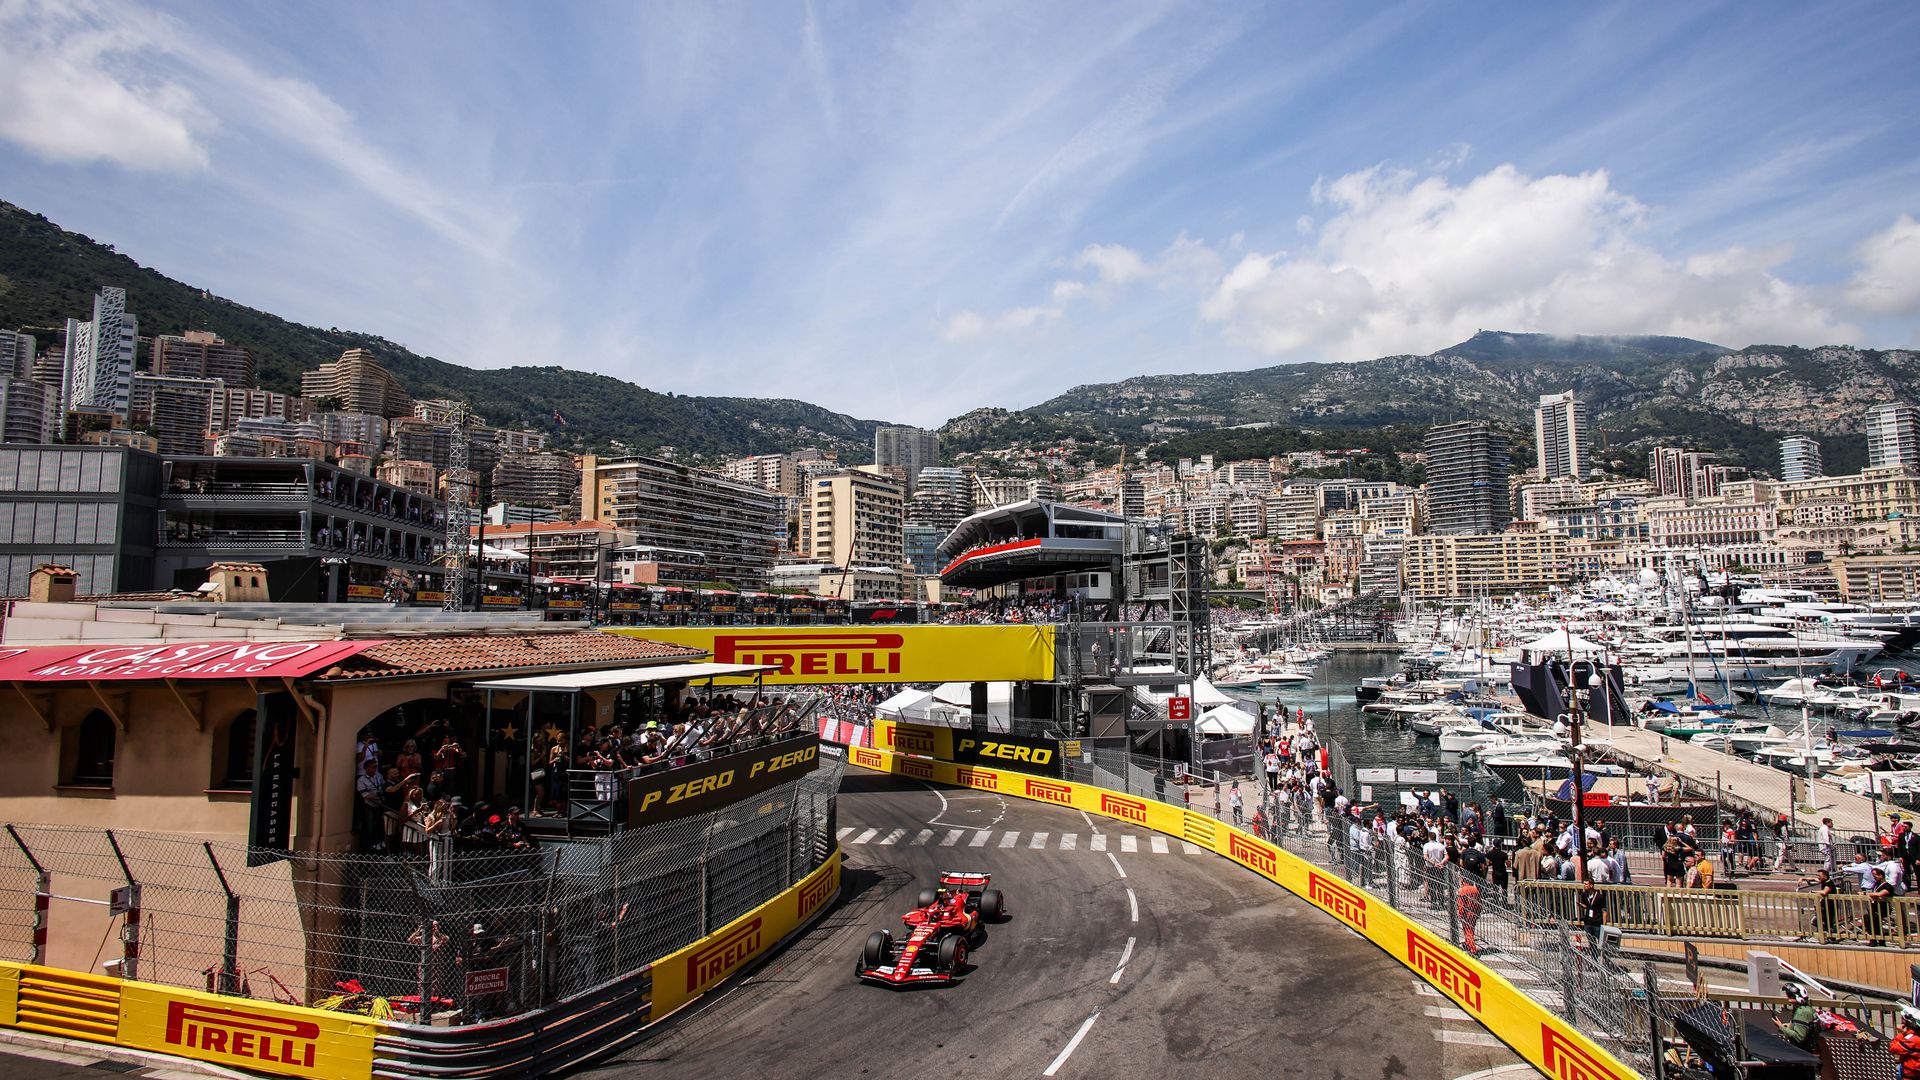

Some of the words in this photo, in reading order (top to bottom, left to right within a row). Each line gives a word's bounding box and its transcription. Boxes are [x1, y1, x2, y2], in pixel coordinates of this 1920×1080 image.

[76, 643, 320, 664] CASINO
[714, 633, 904, 677] PIRELLI
[887, 726, 934, 753] PIRELLI
[958, 739, 975, 752] P
[979, 741, 1052, 765] ZERO
[273, 753, 281, 768] LA
[750, 762, 765, 778] P
[768, 746, 816, 773] ZERO
[856, 750, 882, 768] PIRELLI
[900, 759, 934, 780] PIRELLI
[640, 790, 662, 812] P
[666, 769, 735, 804] ZERO
[957, 768, 997, 790] PIRELLI
[1026, 779, 1072, 804] PIRELLI
[268, 774, 280, 843] RASCASSE
[1101, 793, 1147, 823] PIRELLI
[1583, 793, 1608, 801] SORTIE
[1229, 832, 1277, 877] PIRELLI
[797, 863, 835, 920] PIRELLI
[1309, 871, 1367, 931] PIRELLI
[687, 916, 763, 994] PIRELLI
[474, 973, 500, 982] BOUCHE
[1406, 928, 1482, 1013] PIRELLI
[166, 1000, 321, 1069] PIRELLI
